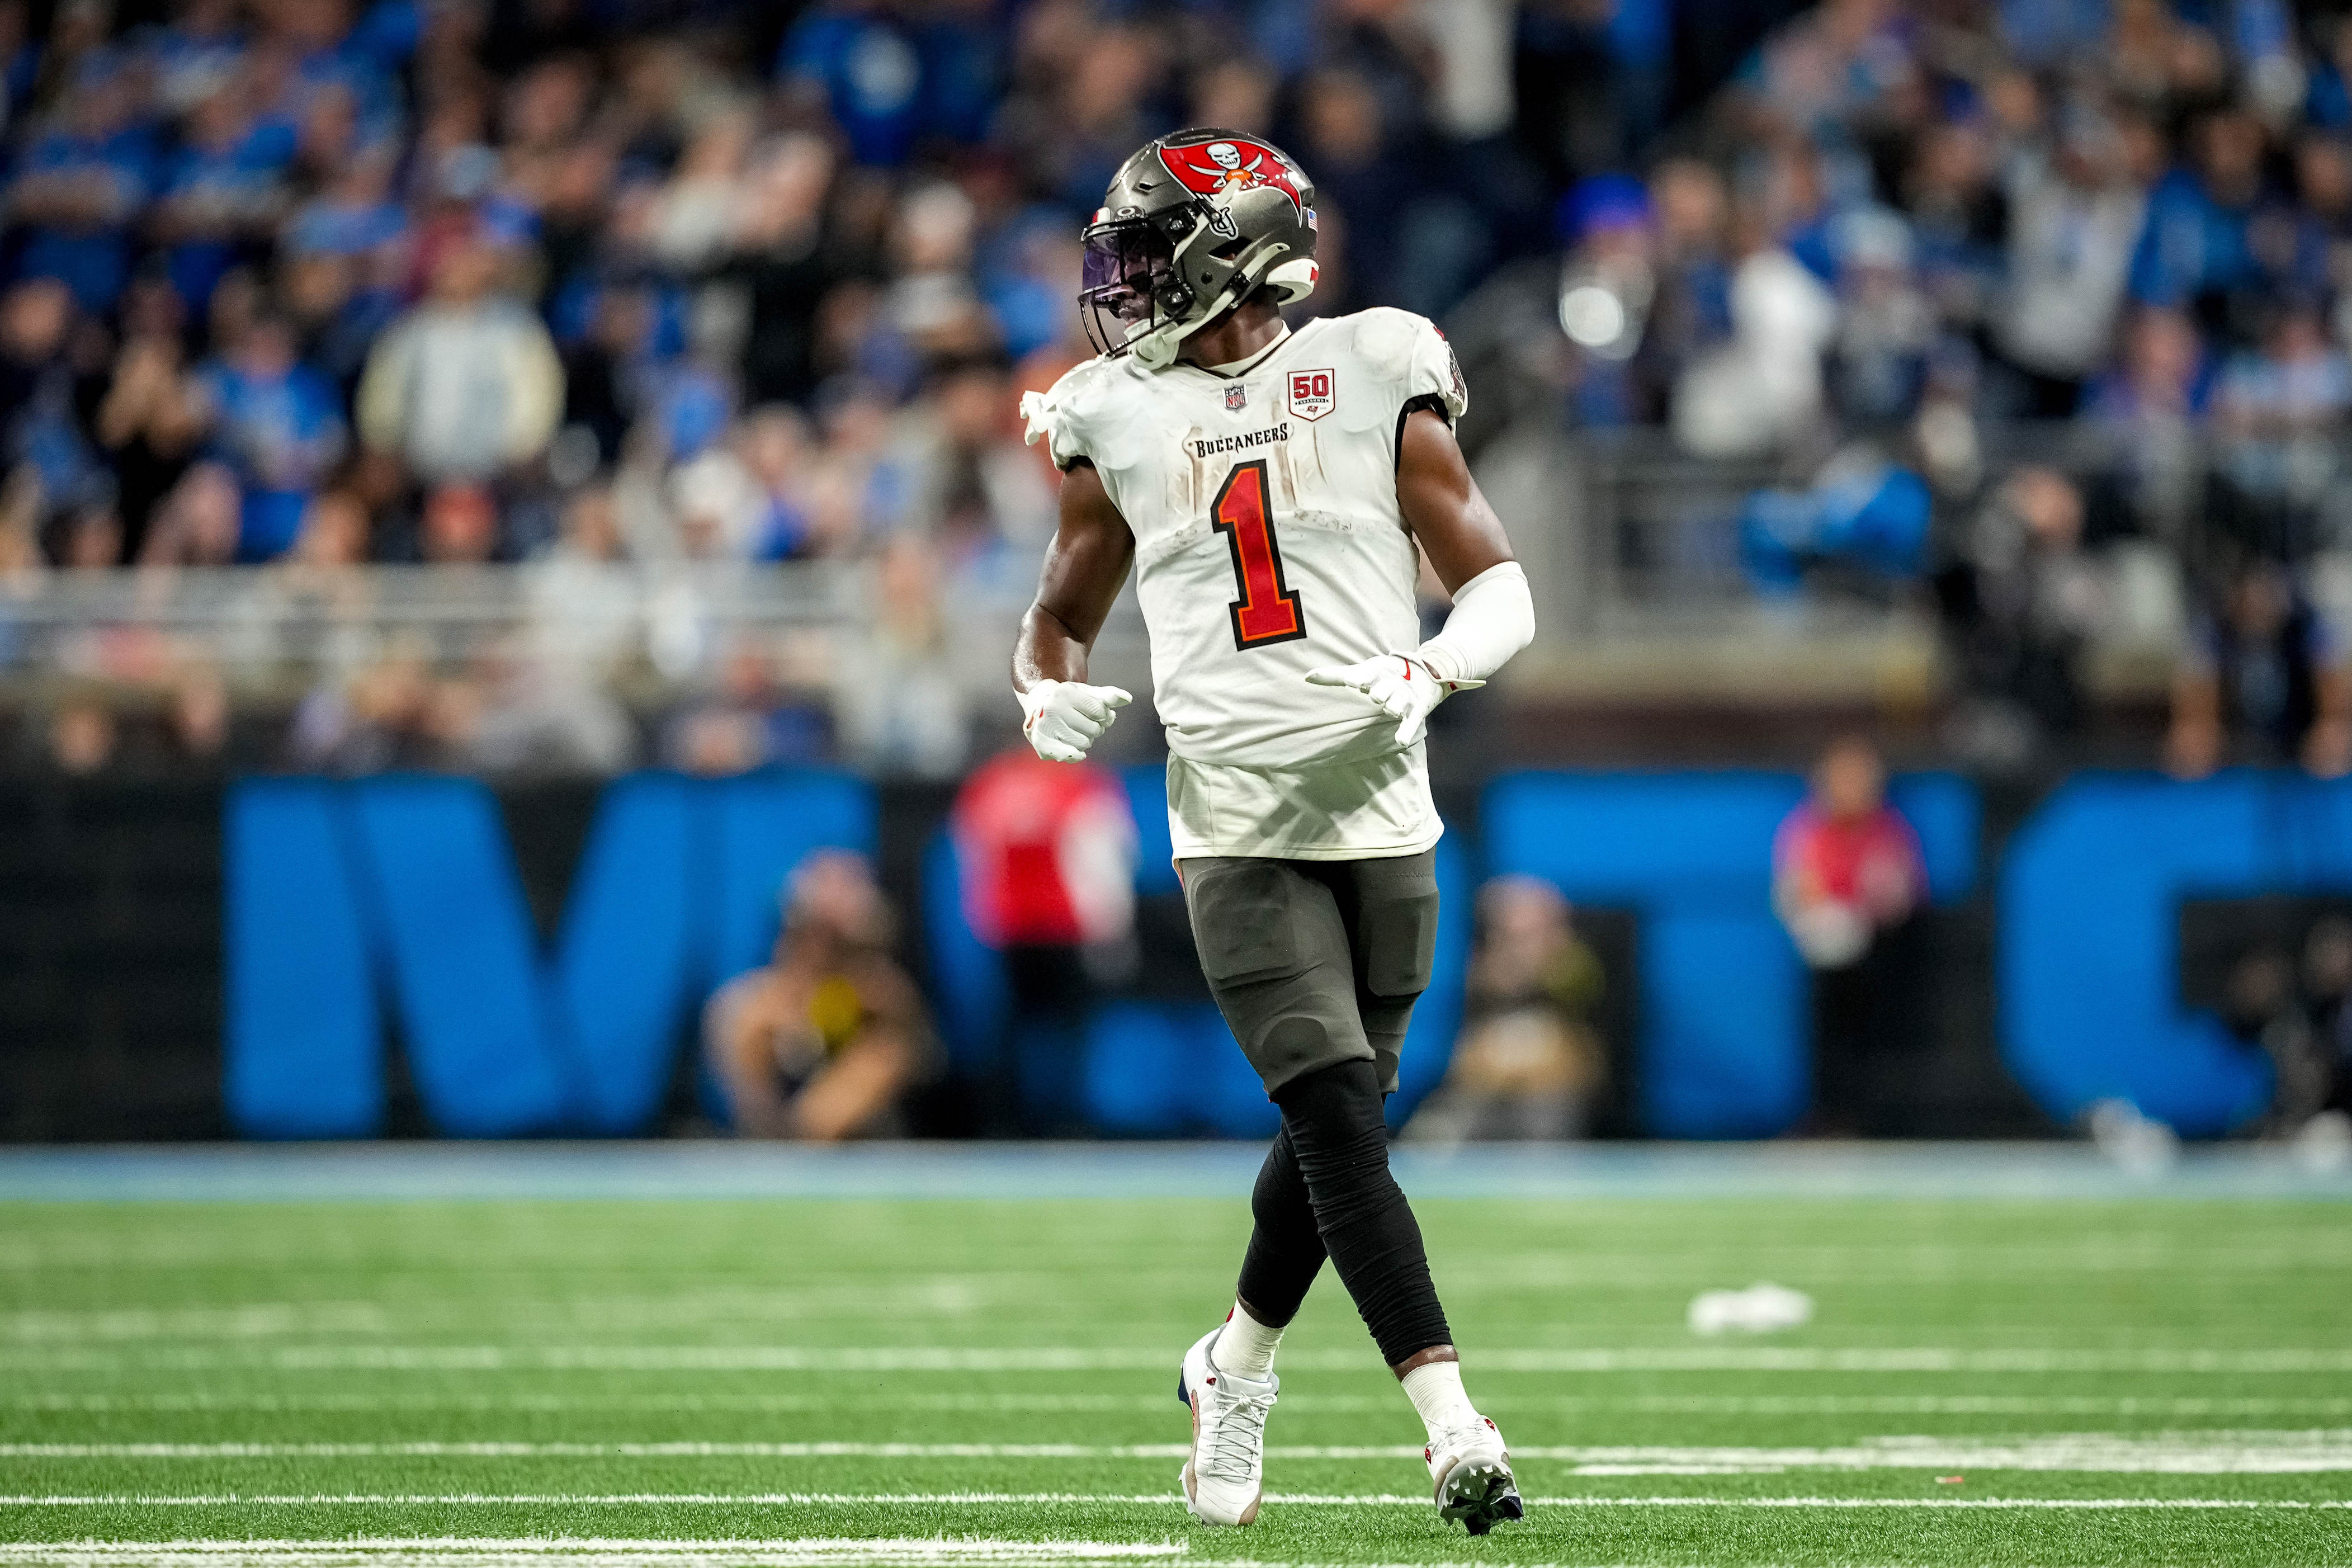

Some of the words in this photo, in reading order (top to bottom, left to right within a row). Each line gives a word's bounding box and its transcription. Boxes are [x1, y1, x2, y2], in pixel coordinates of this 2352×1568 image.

[1226, 394, 1245, 408] NFL
[1293, 375, 1329, 399] 50
[1195, 422, 1288, 457] BUCCANEERS
[1211, 459, 1307, 651] 1
